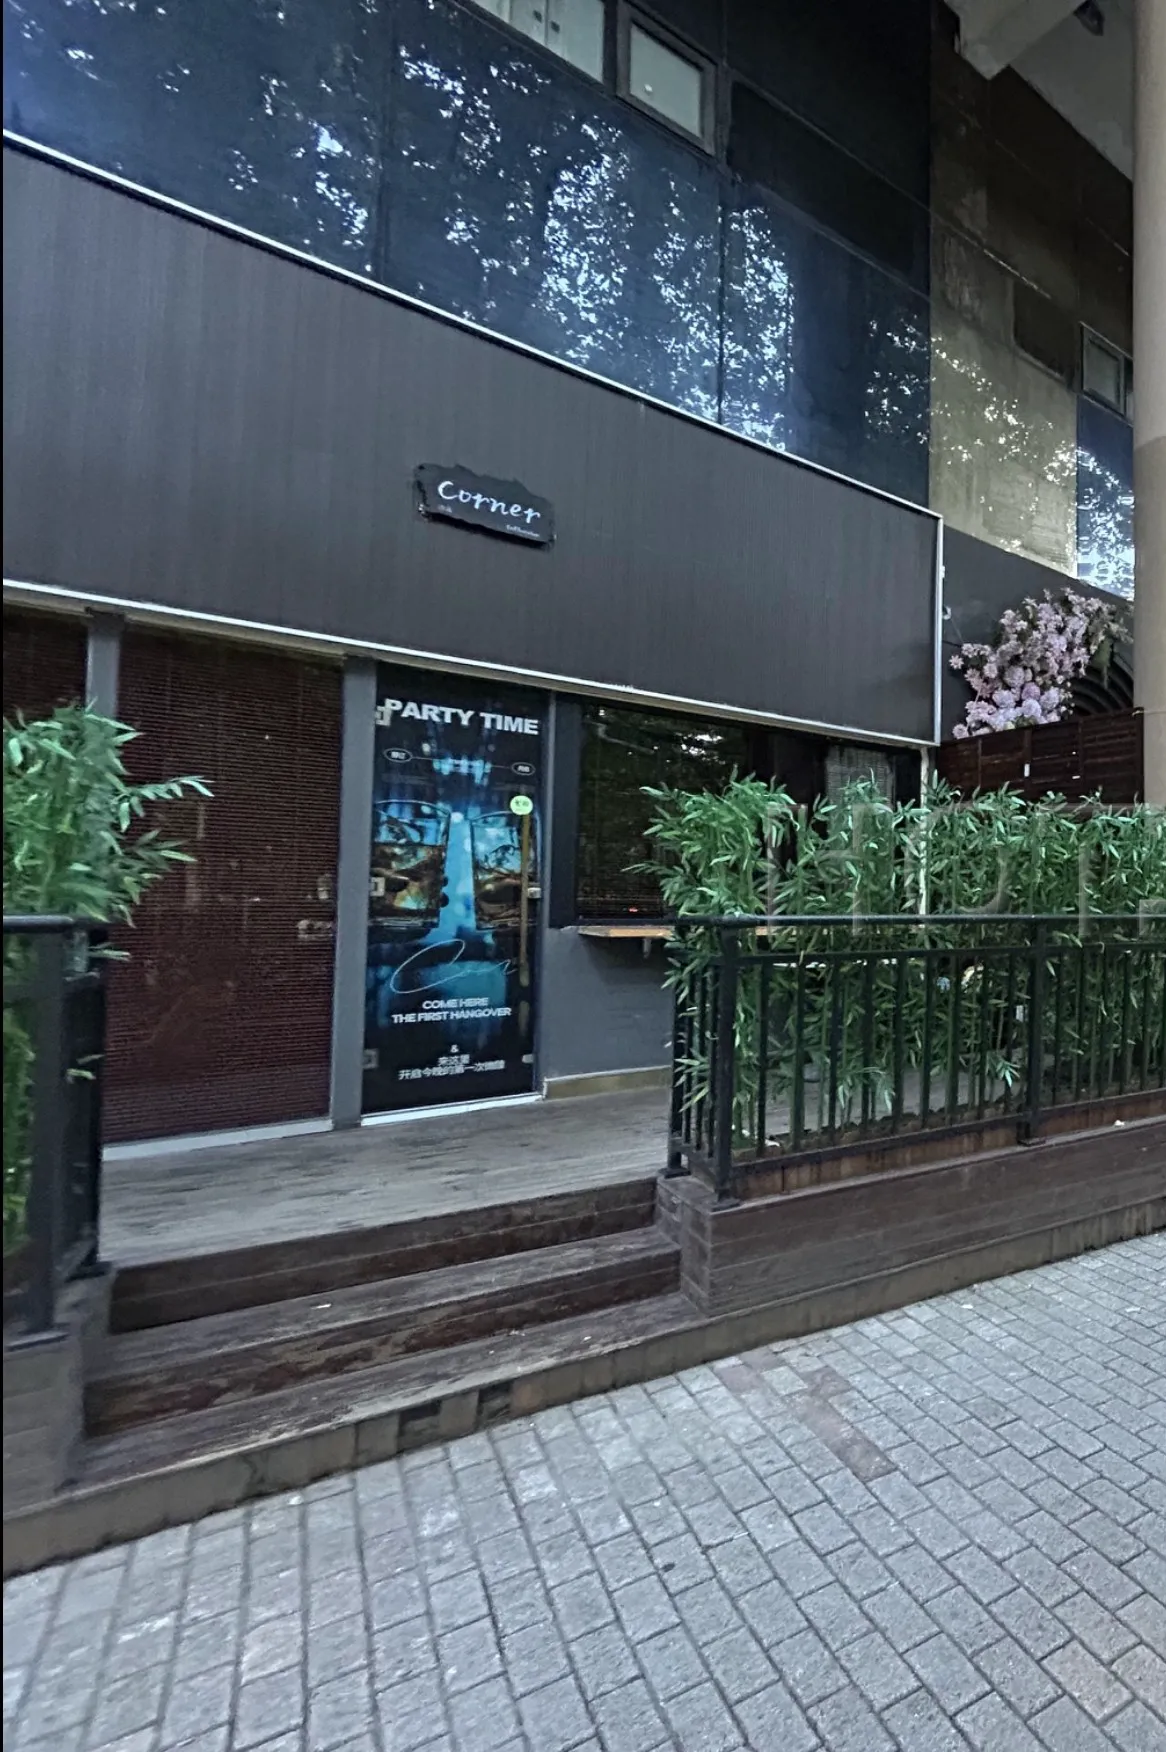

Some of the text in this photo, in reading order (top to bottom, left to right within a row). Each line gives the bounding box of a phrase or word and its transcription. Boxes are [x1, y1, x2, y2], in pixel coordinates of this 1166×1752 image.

[437, 480, 541, 524] Corner
[385, 698, 539, 735] PARTY TIME
[421, 997, 489, 1010] COME HERE
[392, 1007, 512, 1024] THE FIRST HANGOVER
[450, 1044, 459, 1053] &
